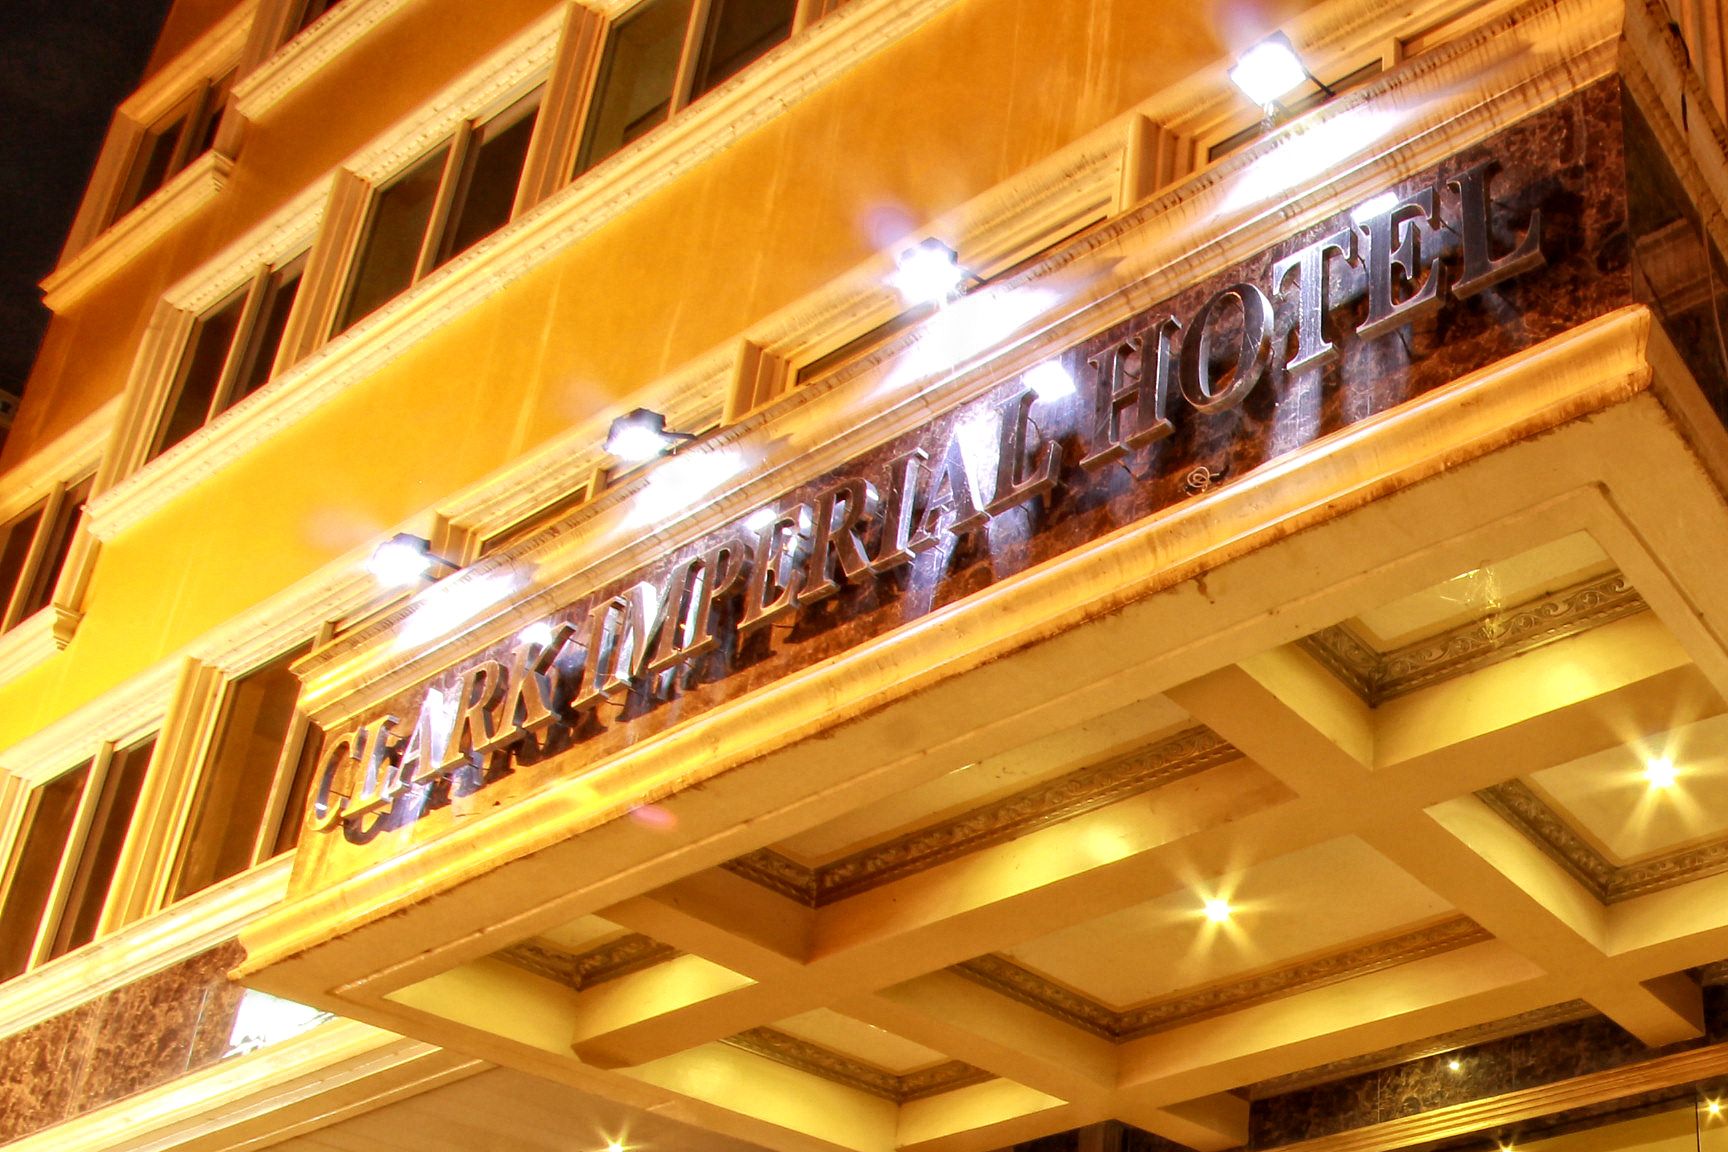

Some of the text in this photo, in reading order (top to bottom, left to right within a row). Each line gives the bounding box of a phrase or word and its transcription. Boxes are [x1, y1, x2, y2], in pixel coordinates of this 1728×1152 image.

[307, 161, 1548, 834] CLARK IMPERIAL HOTEL
